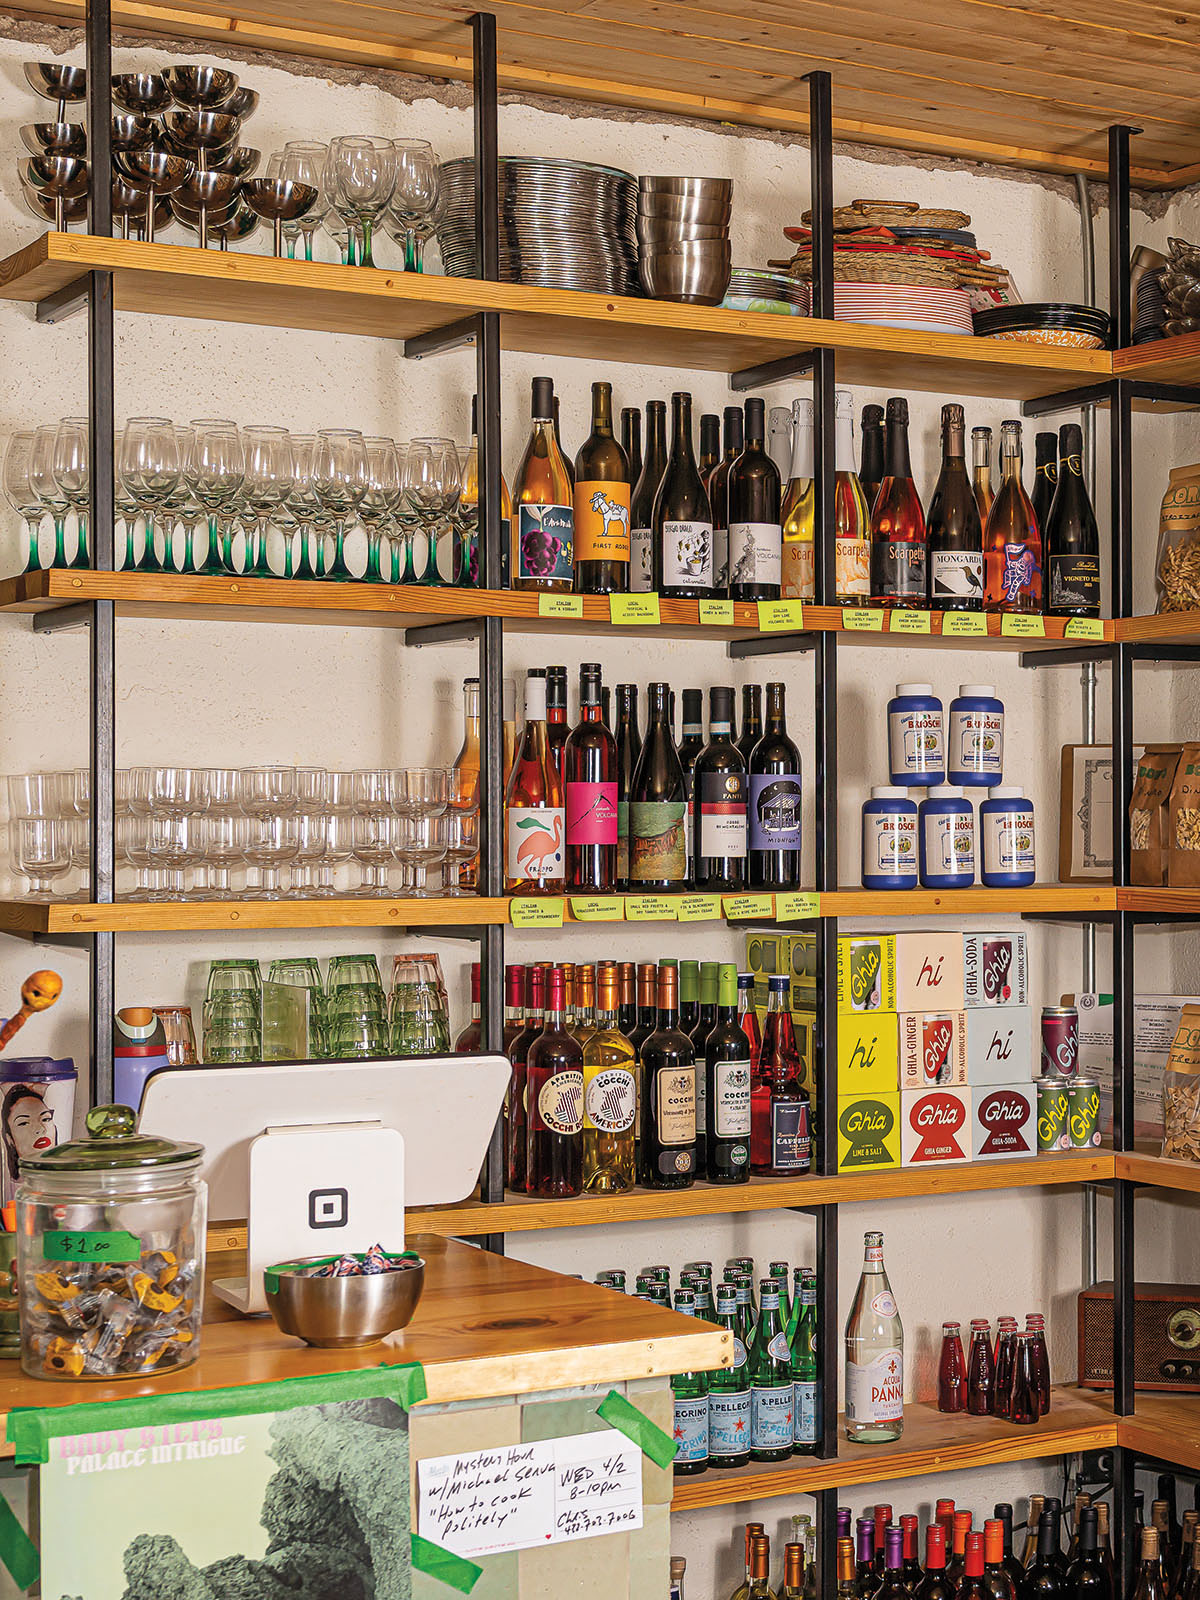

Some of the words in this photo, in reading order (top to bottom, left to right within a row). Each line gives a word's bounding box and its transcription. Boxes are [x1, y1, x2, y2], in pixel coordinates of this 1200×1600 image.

[851, 951, 879, 998] Ghia
[916, 955, 945, 987] hi
[965, 937, 977, 996] GHIA-SODA
[983, 945, 1012, 994] Ghia
[848, 1037, 878, 1068] hi
[906, 1016, 917, 1076] GHIA-GINGER
[924, 1024, 950, 1073] Ghia
[986, 1030, 1014, 1061] hi
[1056, 1023, 1078, 1064] Ghi
[598, 1077, 629, 1088] COCCHI
[543, 1113, 574, 1132] COCCHI
[590, 1109, 635, 1129] AMERICANO
[846, 1112, 888, 1134] Ghia
[917, 1103, 959, 1127] Ghia
[985, 1100, 1024, 1123] Ghia
[1037, 1092, 1069, 1142] Ghia
[1069, 1091, 1100, 1141] Ghia
[852, 1149, 864, 1157] LIME
[870, 1147, 882, 1155] SALT
[924, 1147, 935, 1155] GHIA
[761, 1396, 792, 1406] S.PELLE
[60, 1428, 129, 1459] BABY
[139, 1418, 223, 1450] STEPS
[66, 1448, 148, 1475] PALACE
[151, 1435, 247, 1464] INTRIGUE
[561, 1467, 593, 1487] WED
[603, 1453, 627, 1476] 4/2
